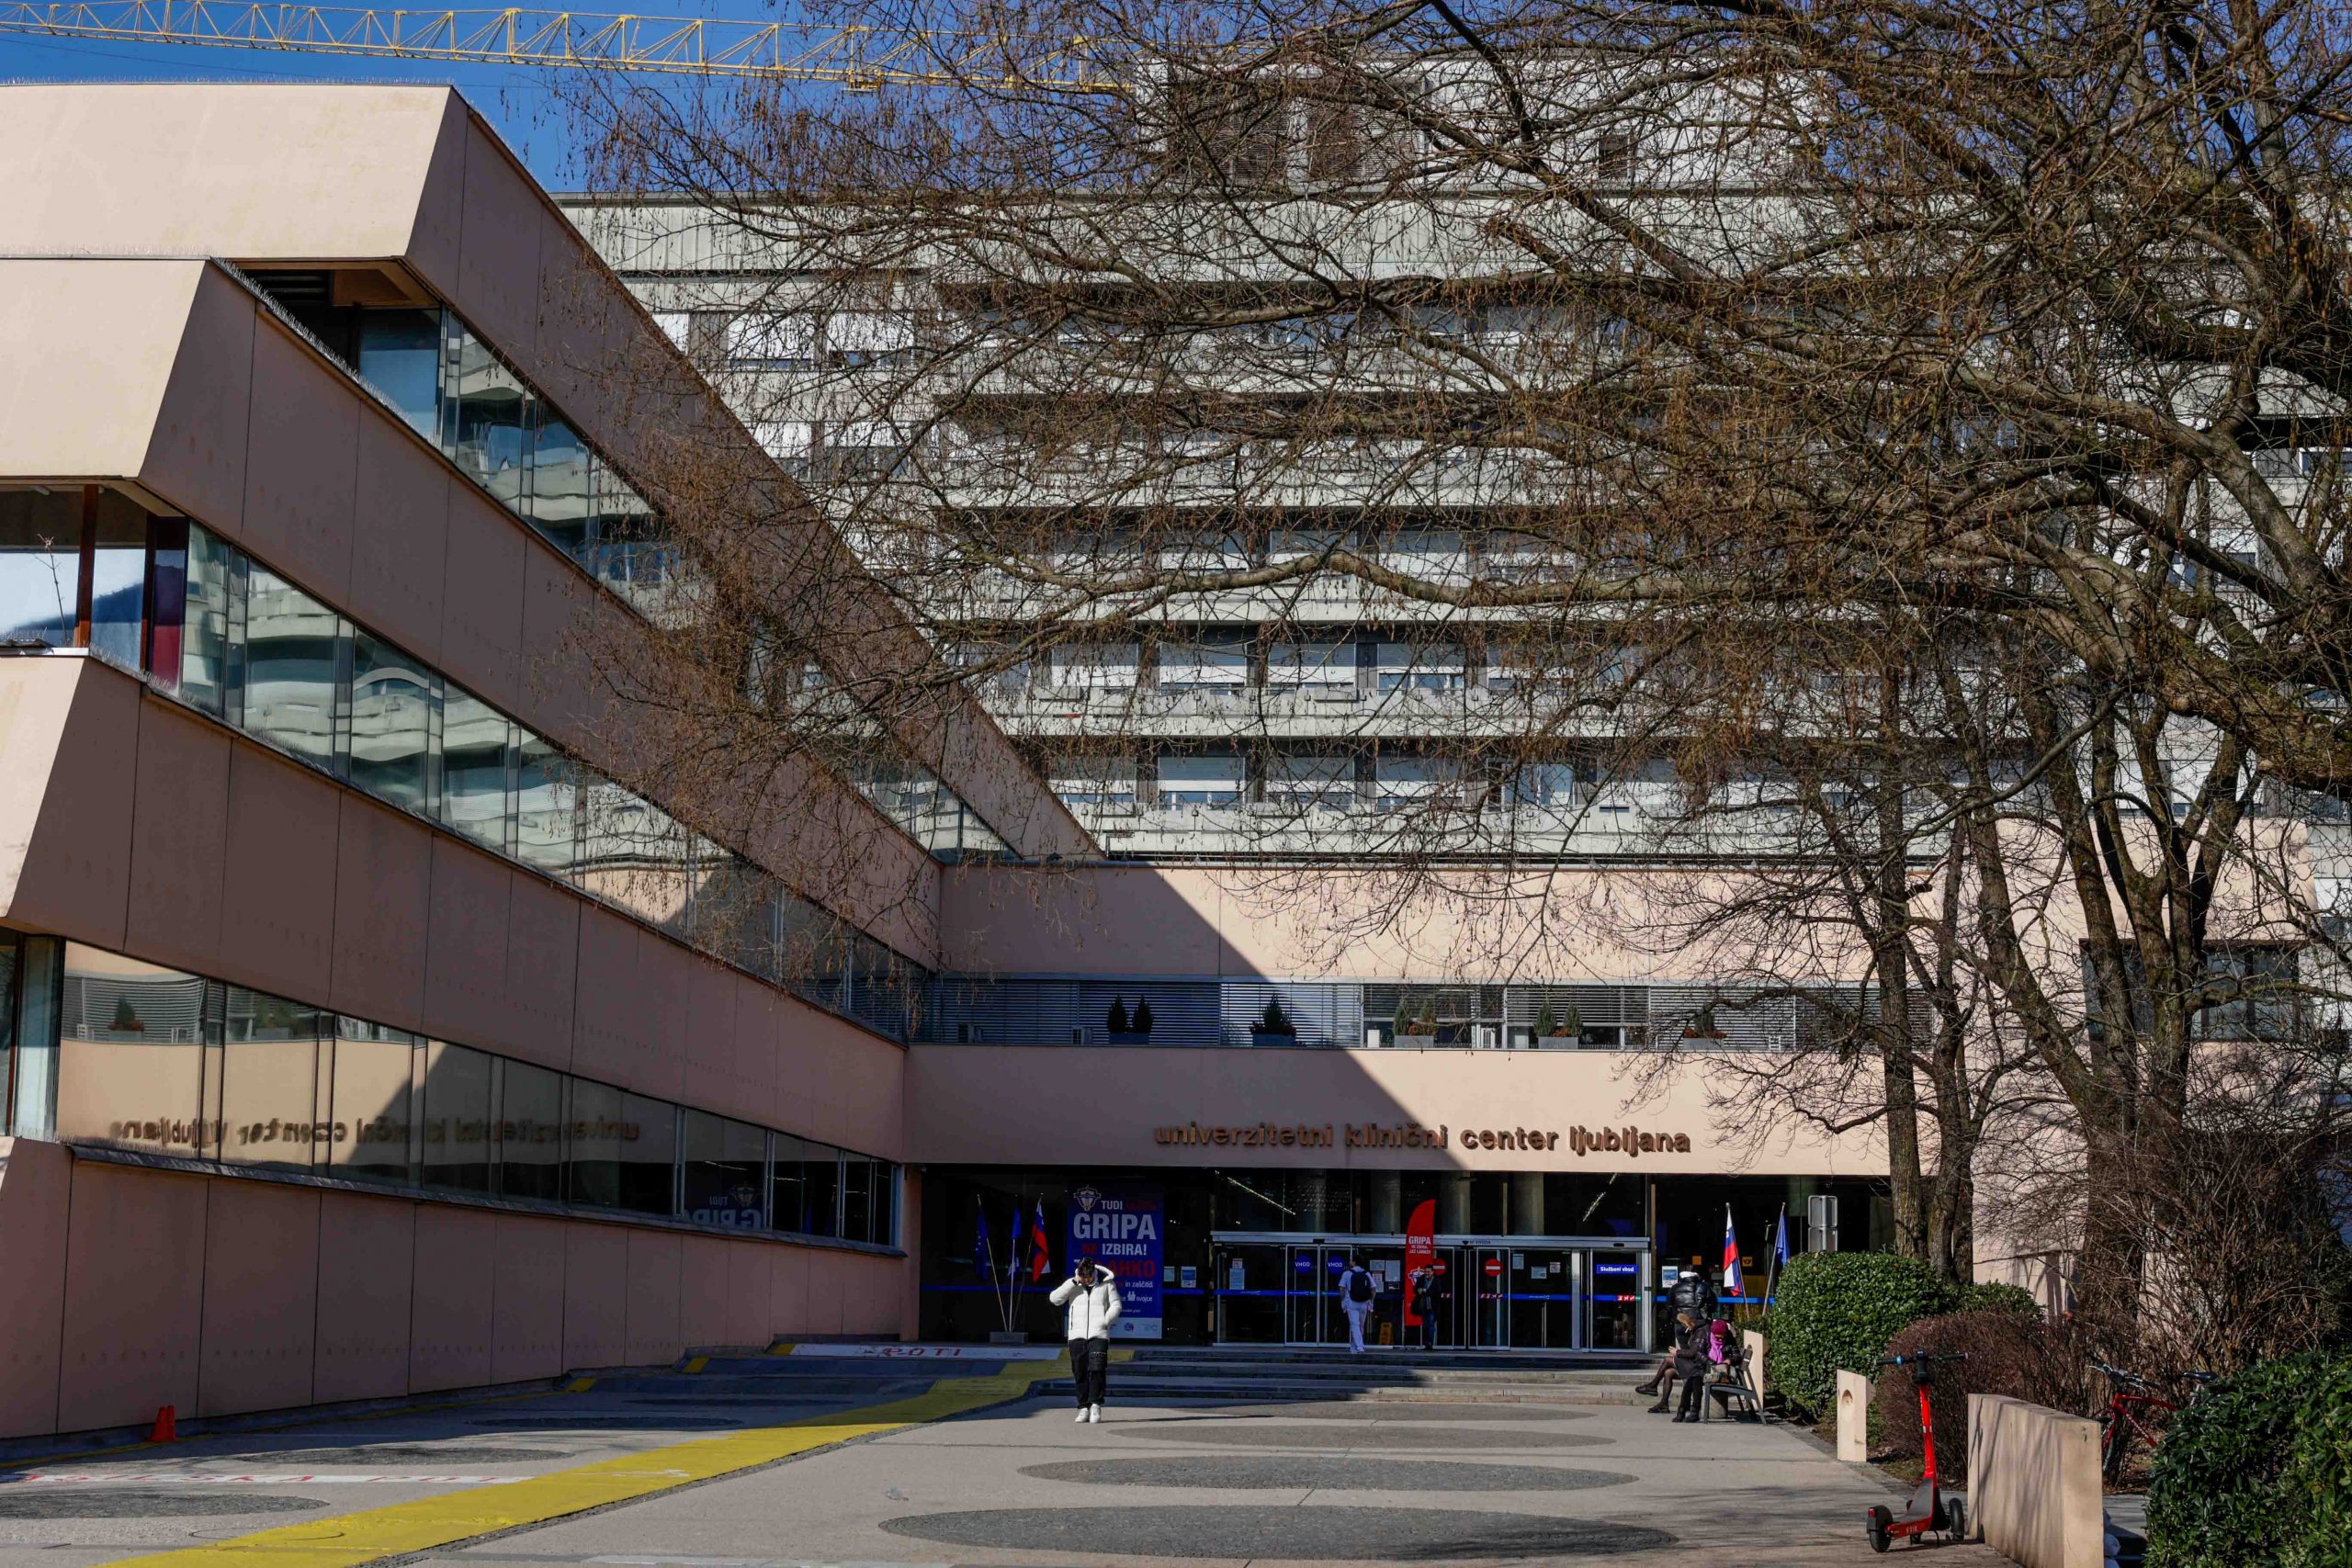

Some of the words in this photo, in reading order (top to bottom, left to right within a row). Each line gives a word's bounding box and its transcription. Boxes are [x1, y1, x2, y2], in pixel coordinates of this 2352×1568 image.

[1155, 1121, 1333, 1147] univerzitetni
[1346, 1122, 1449, 1150] klinični
[1460, 1126, 1559, 1152] center
[1569, 1125, 1691, 1157] ljubljana
[1101, 1200, 1123, 1211] TUDI
[1073, 1213, 1157, 1240] GRIPA
[1408, 1235, 1431, 1245] GRIPA
[1102, 1242, 1148, 1256] IZBIRA!
